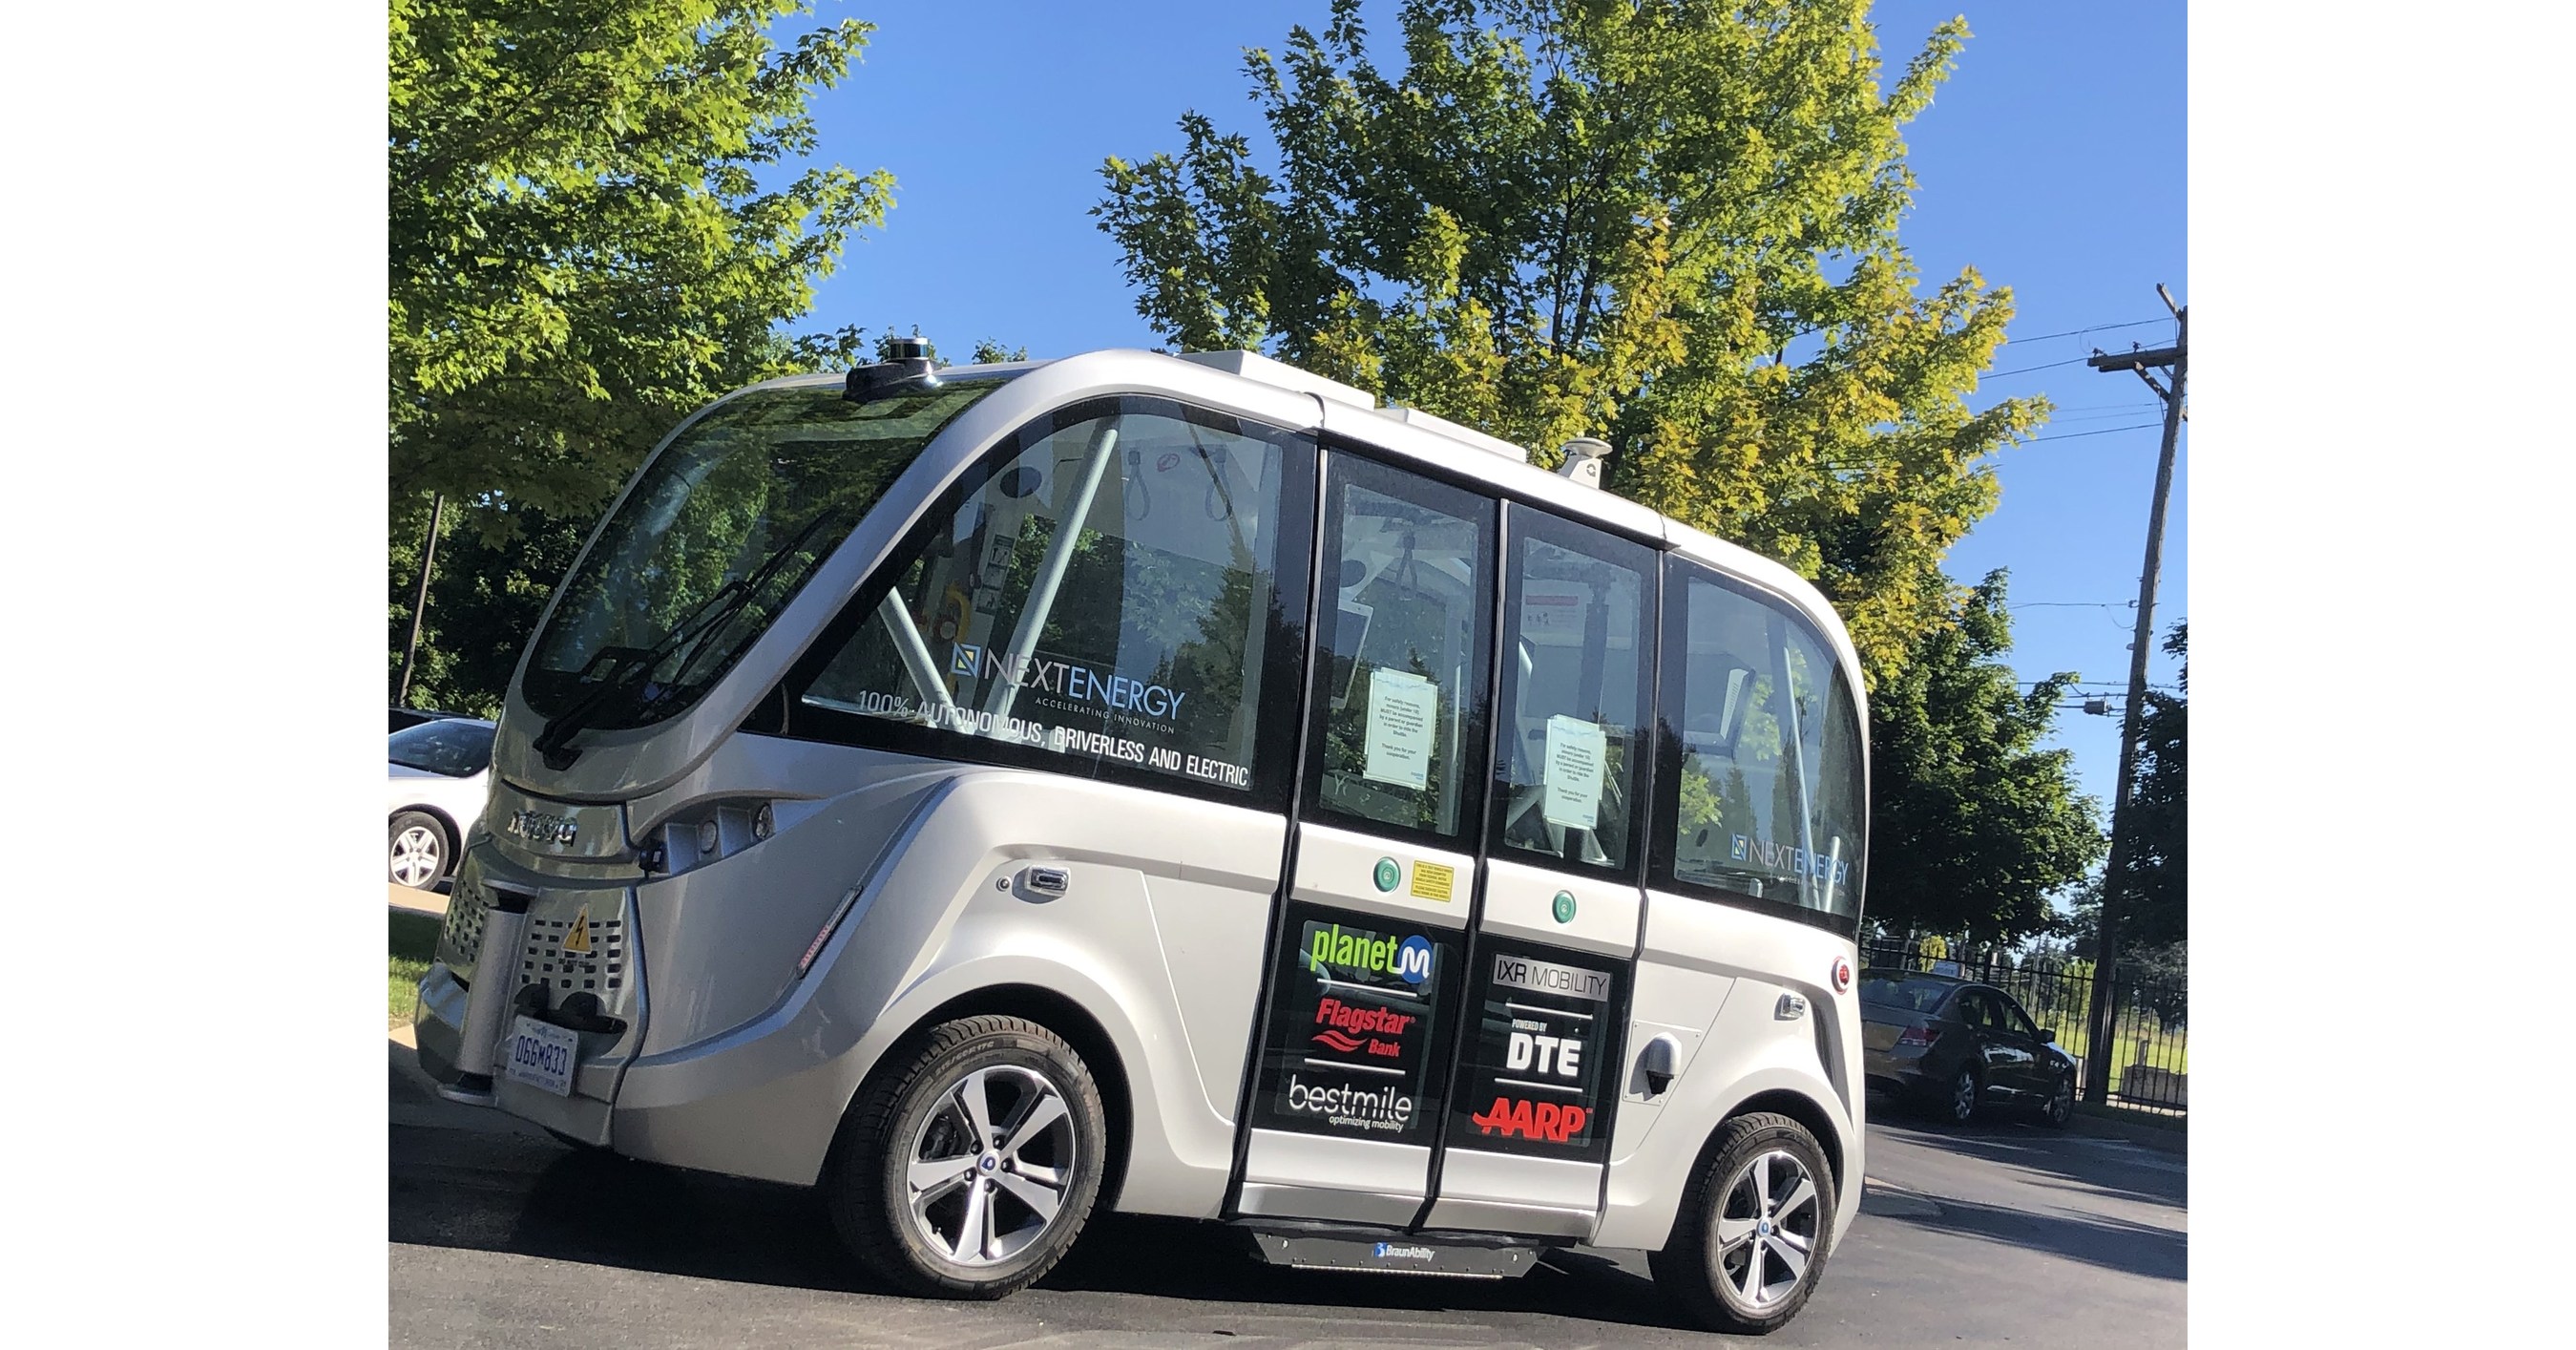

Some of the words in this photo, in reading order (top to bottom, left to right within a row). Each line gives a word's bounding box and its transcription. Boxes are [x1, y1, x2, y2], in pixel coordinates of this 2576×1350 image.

[984, 647, 1186, 721] NEXTENERGY
[1035, 697, 1110, 720] ACCELERATING
[1114, 713, 1175, 734] INNOVATION
[859, 690, 909, 717] 100%
[1054, 726, 1145, 763] DRIVERLESS
[1148, 747, 1181, 770] AND
[1185, 755, 1248, 787] ELECTRIC
[1749, 837, 1849, 886] NEXTENERGY
[1497, 960, 1527, 984] IXR
[1531, 965, 1607, 996] MOBILITY
[1511, 1018, 1539, 1031] POWERED
[1539, 1022, 1548, 1032] BY
[1368, 1038, 1401, 1057] Bank
[1506, 1031, 1582, 1077] DTE
[1288, 1073, 1413, 1122] bestmile
[1329, 1114, 1371, 1130] optimizing
[1371, 1119, 1404, 1134] mobility
[1472, 1097, 1586, 1142] AARP
[1386, 1244, 1435, 1262] BraunAbility
